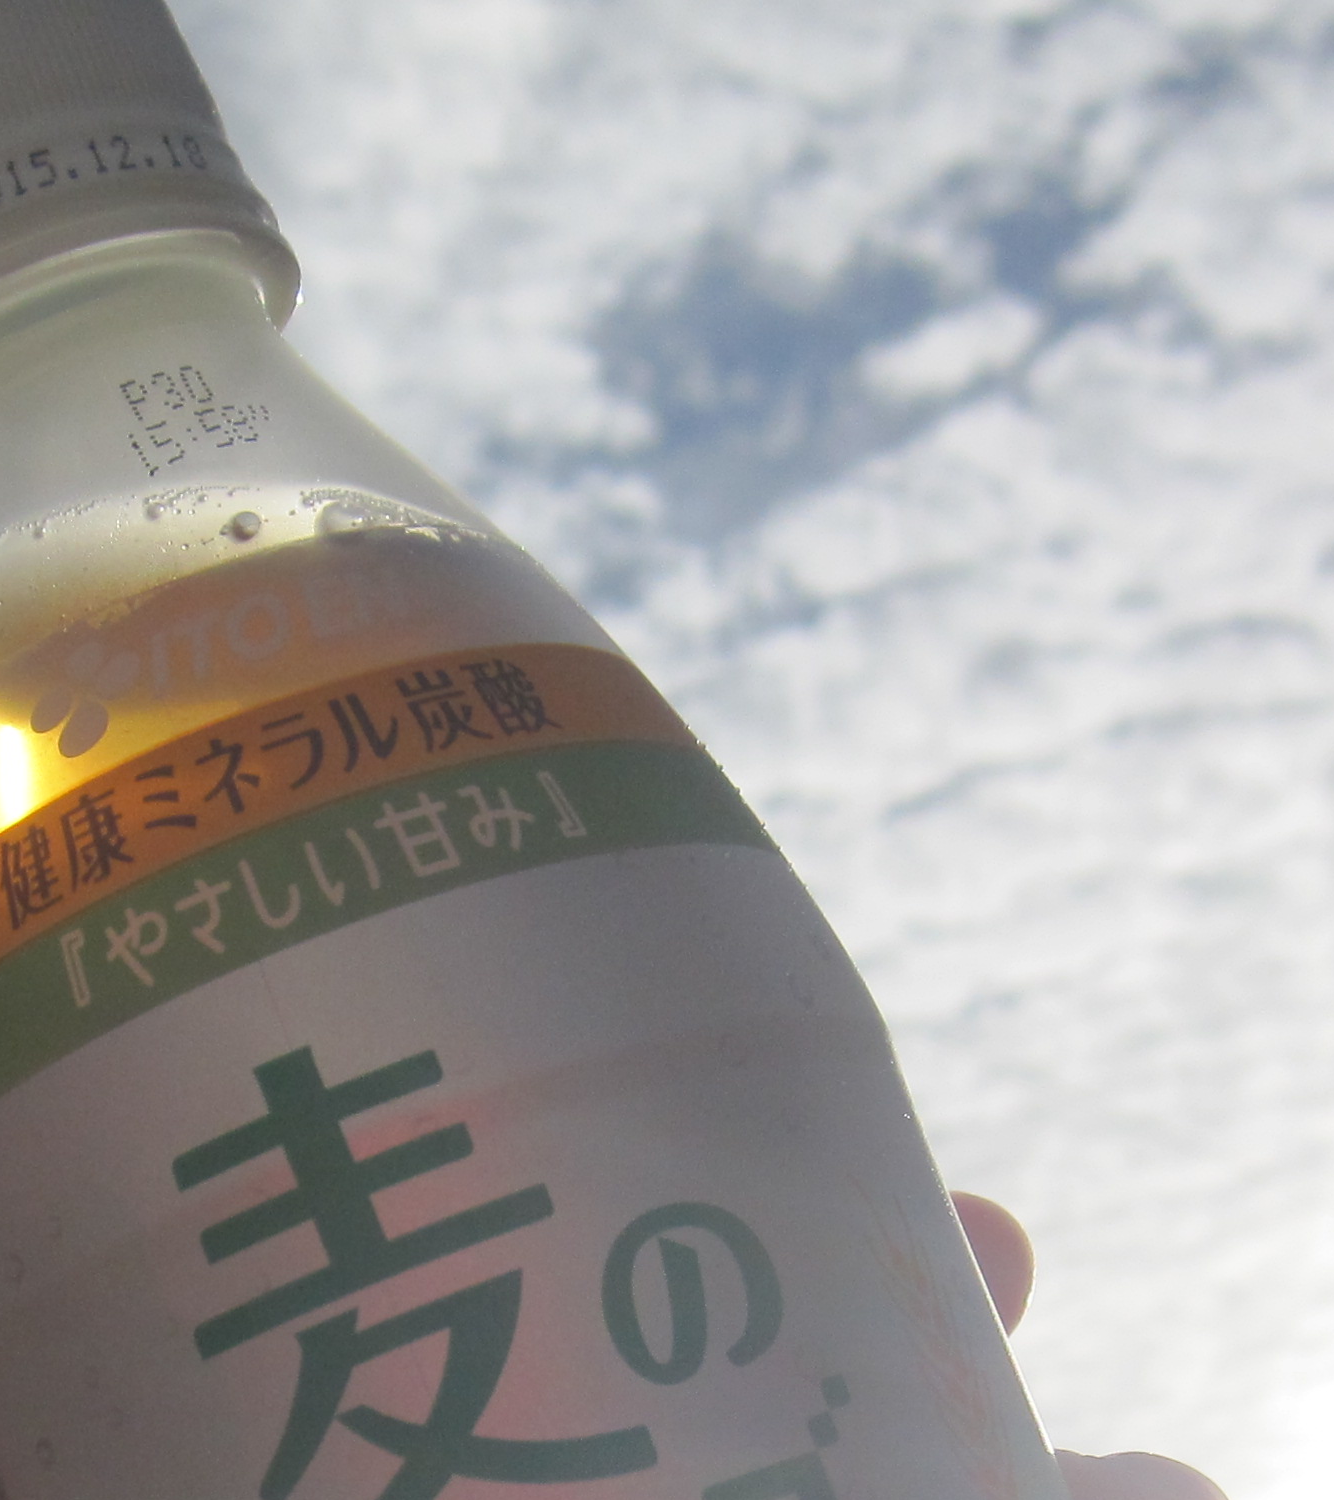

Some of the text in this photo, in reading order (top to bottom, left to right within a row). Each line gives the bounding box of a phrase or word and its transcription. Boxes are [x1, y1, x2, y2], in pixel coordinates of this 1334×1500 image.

[119, 365, 214, 422] P30
[151, 592, 290, 694] ITO
[58, 771, 586, 1007] 『やさしい甘み』
